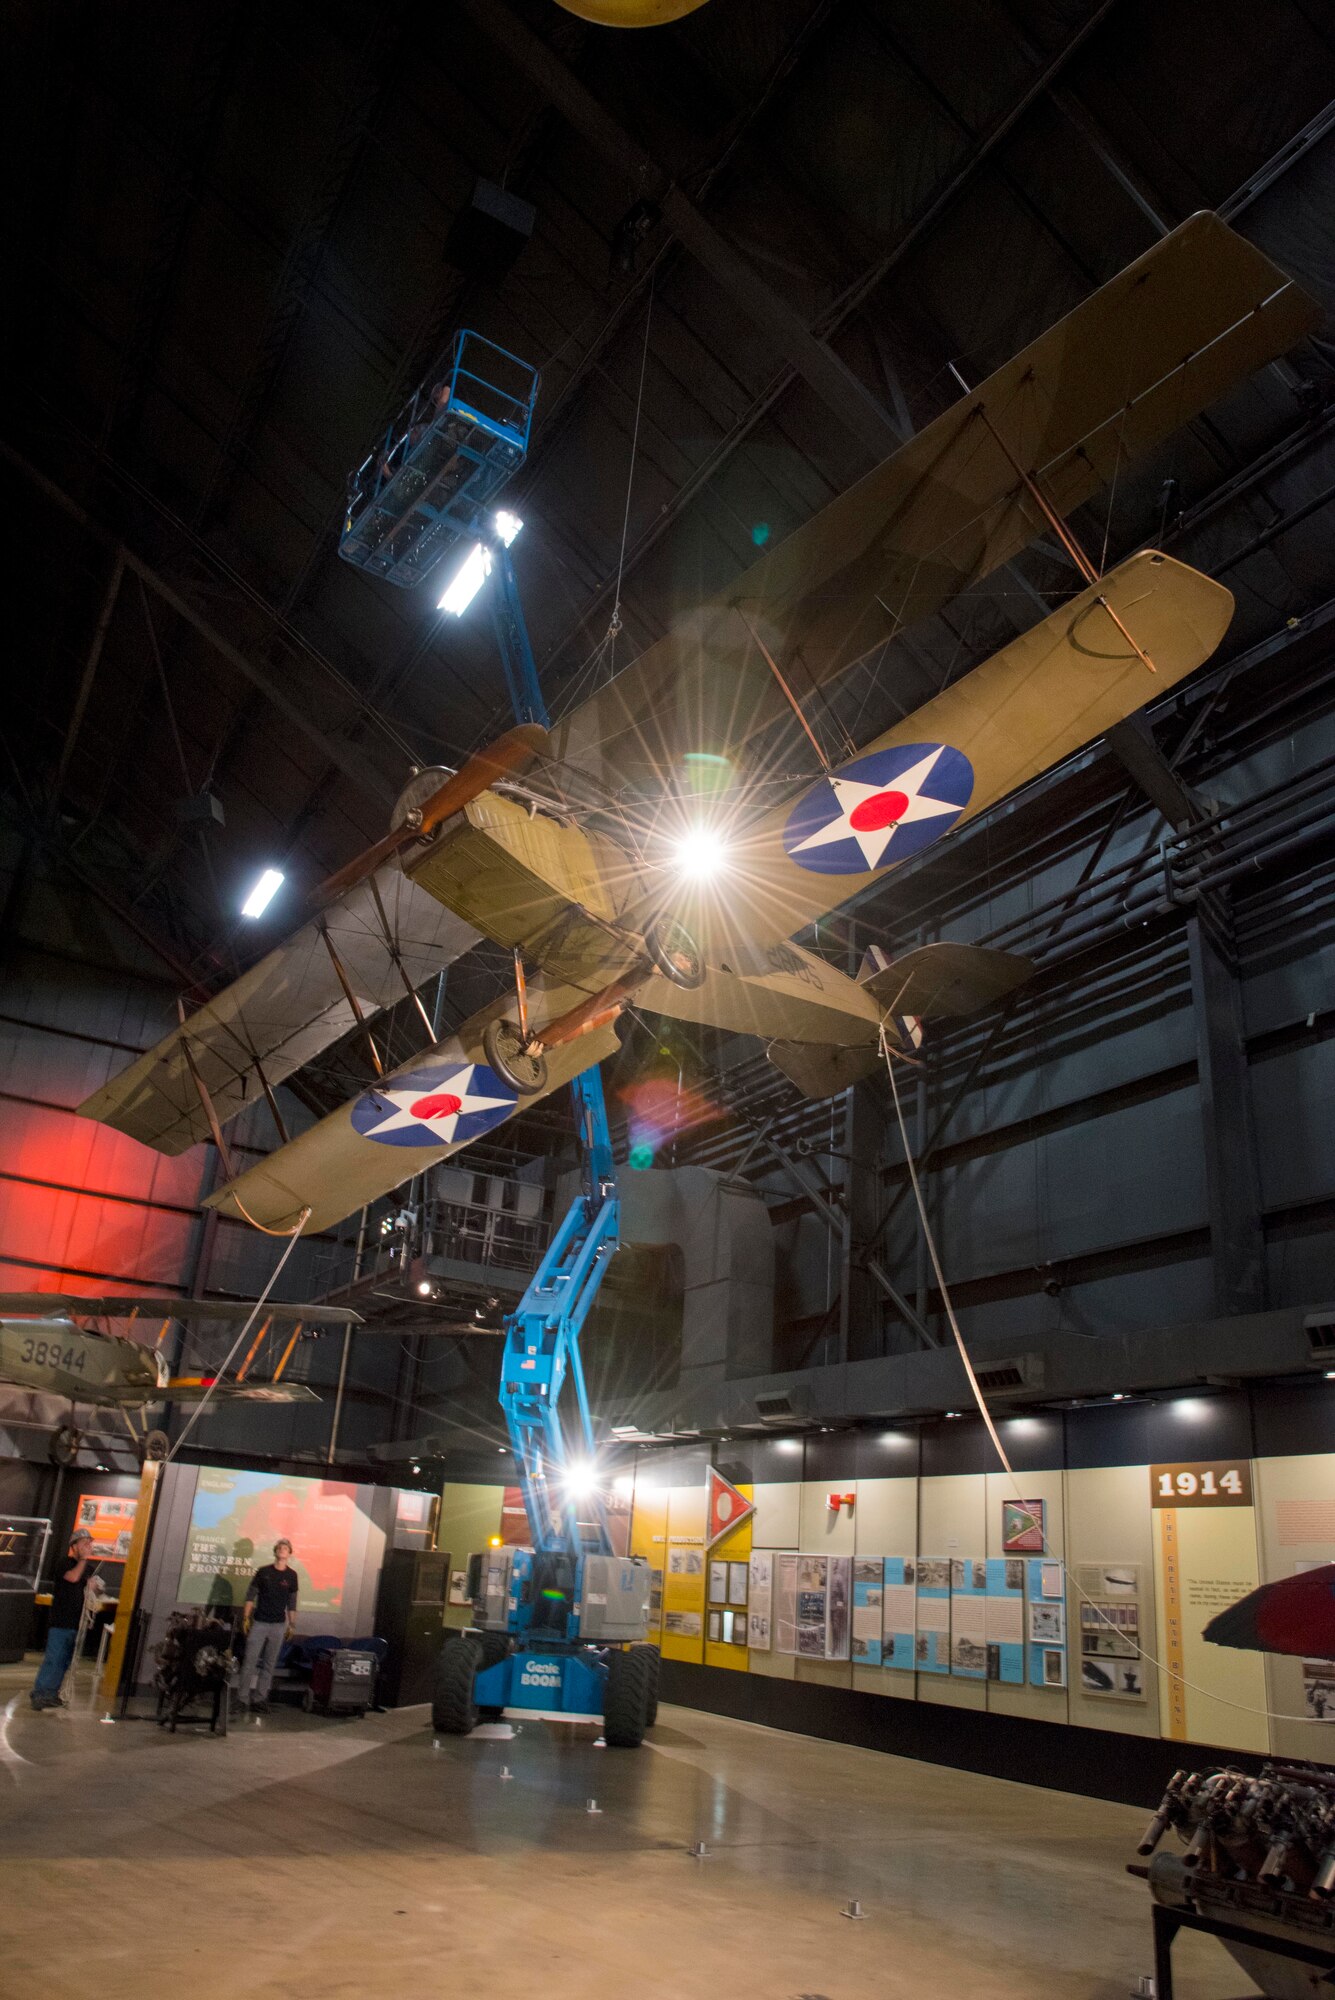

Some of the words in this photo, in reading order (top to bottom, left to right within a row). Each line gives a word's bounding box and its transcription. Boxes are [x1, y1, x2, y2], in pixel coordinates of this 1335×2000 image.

[21, 1339, 86, 1372] 38944
[1158, 1469, 1243, 1496] 1914
[192, 1542, 217, 1553] THE
[191, 1553, 253, 1567] WESTERN
[189, 1563, 230, 1576] FRONT
[526, 1660, 560, 1674] Genie
[521, 1673, 561, 1688] BOOM
